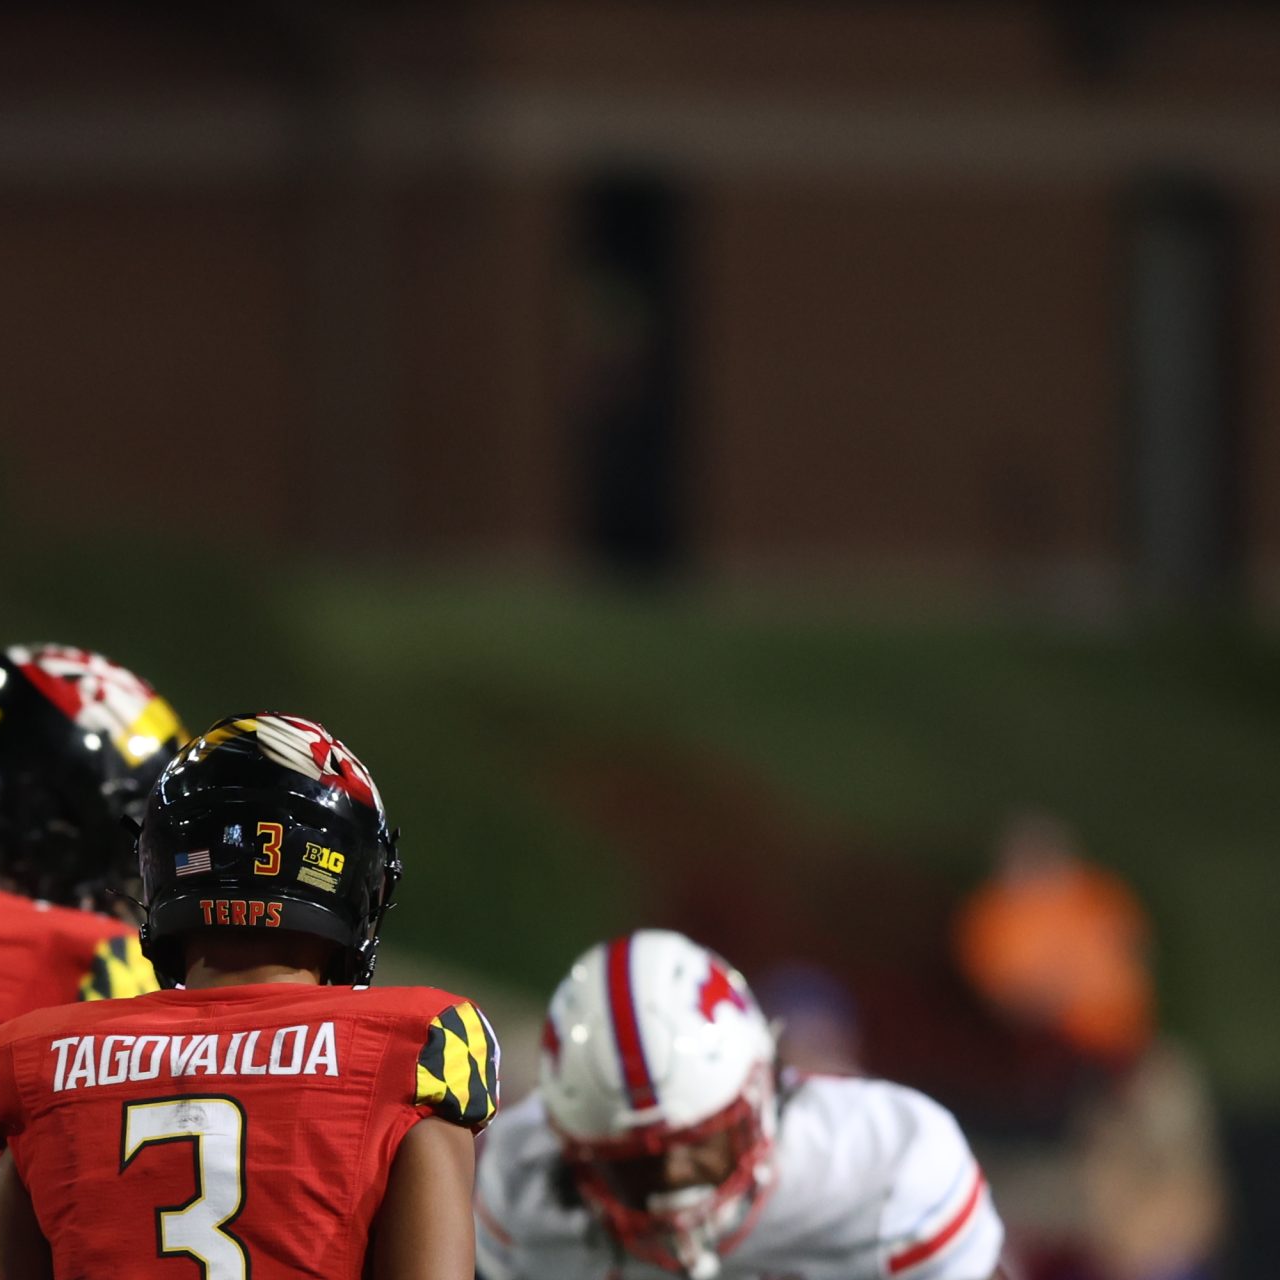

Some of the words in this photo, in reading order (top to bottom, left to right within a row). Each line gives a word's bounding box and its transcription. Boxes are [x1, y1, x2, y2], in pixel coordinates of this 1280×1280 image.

[253, 822, 283, 876] 3
[200, 900, 283, 927] TERPS
[50, 1021, 339, 1093] TAGOVAILOA
